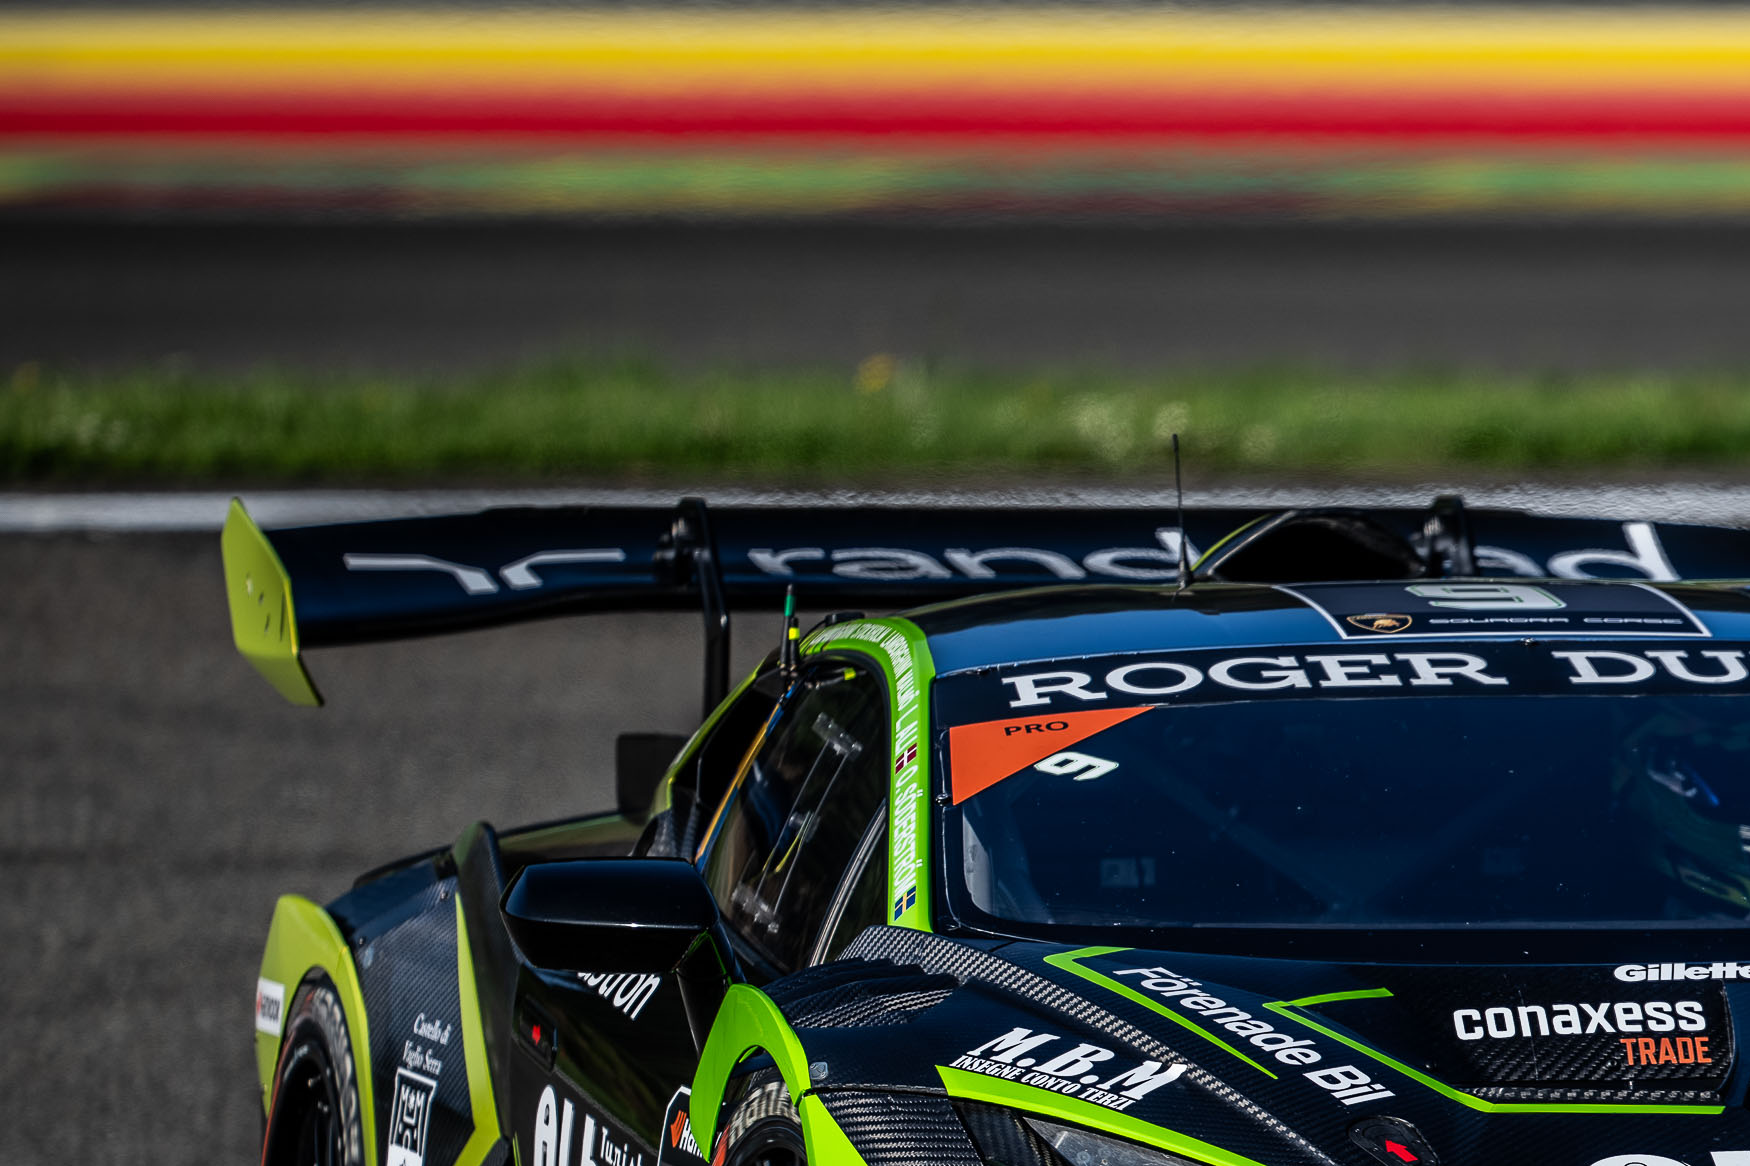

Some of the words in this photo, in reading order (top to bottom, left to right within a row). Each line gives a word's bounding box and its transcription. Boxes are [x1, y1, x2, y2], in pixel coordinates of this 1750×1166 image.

[1404, 584, 1567, 610] 9
[1000, 651, 1509, 708] ROGER
[1004, 721, 1069, 737] PRO
[1033, 751, 1120, 781] 9
[894, 782, 924, 904] SÖDERSTRÖM
[1113, 966, 1322, 1066] Förenade
[1303, 1065, 1396, 1106] Bil
[1452, 999, 1707, 1042] conaxess
[422, 1048, 442, 1076] Serra
[1620, 1037, 1713, 1067] TRADE
[948, 1055, 1026, 1080] INSEGNE
[1020, 1072, 1082, 1095] CONTO
[1078, 1086, 1136, 1111] TERZI
